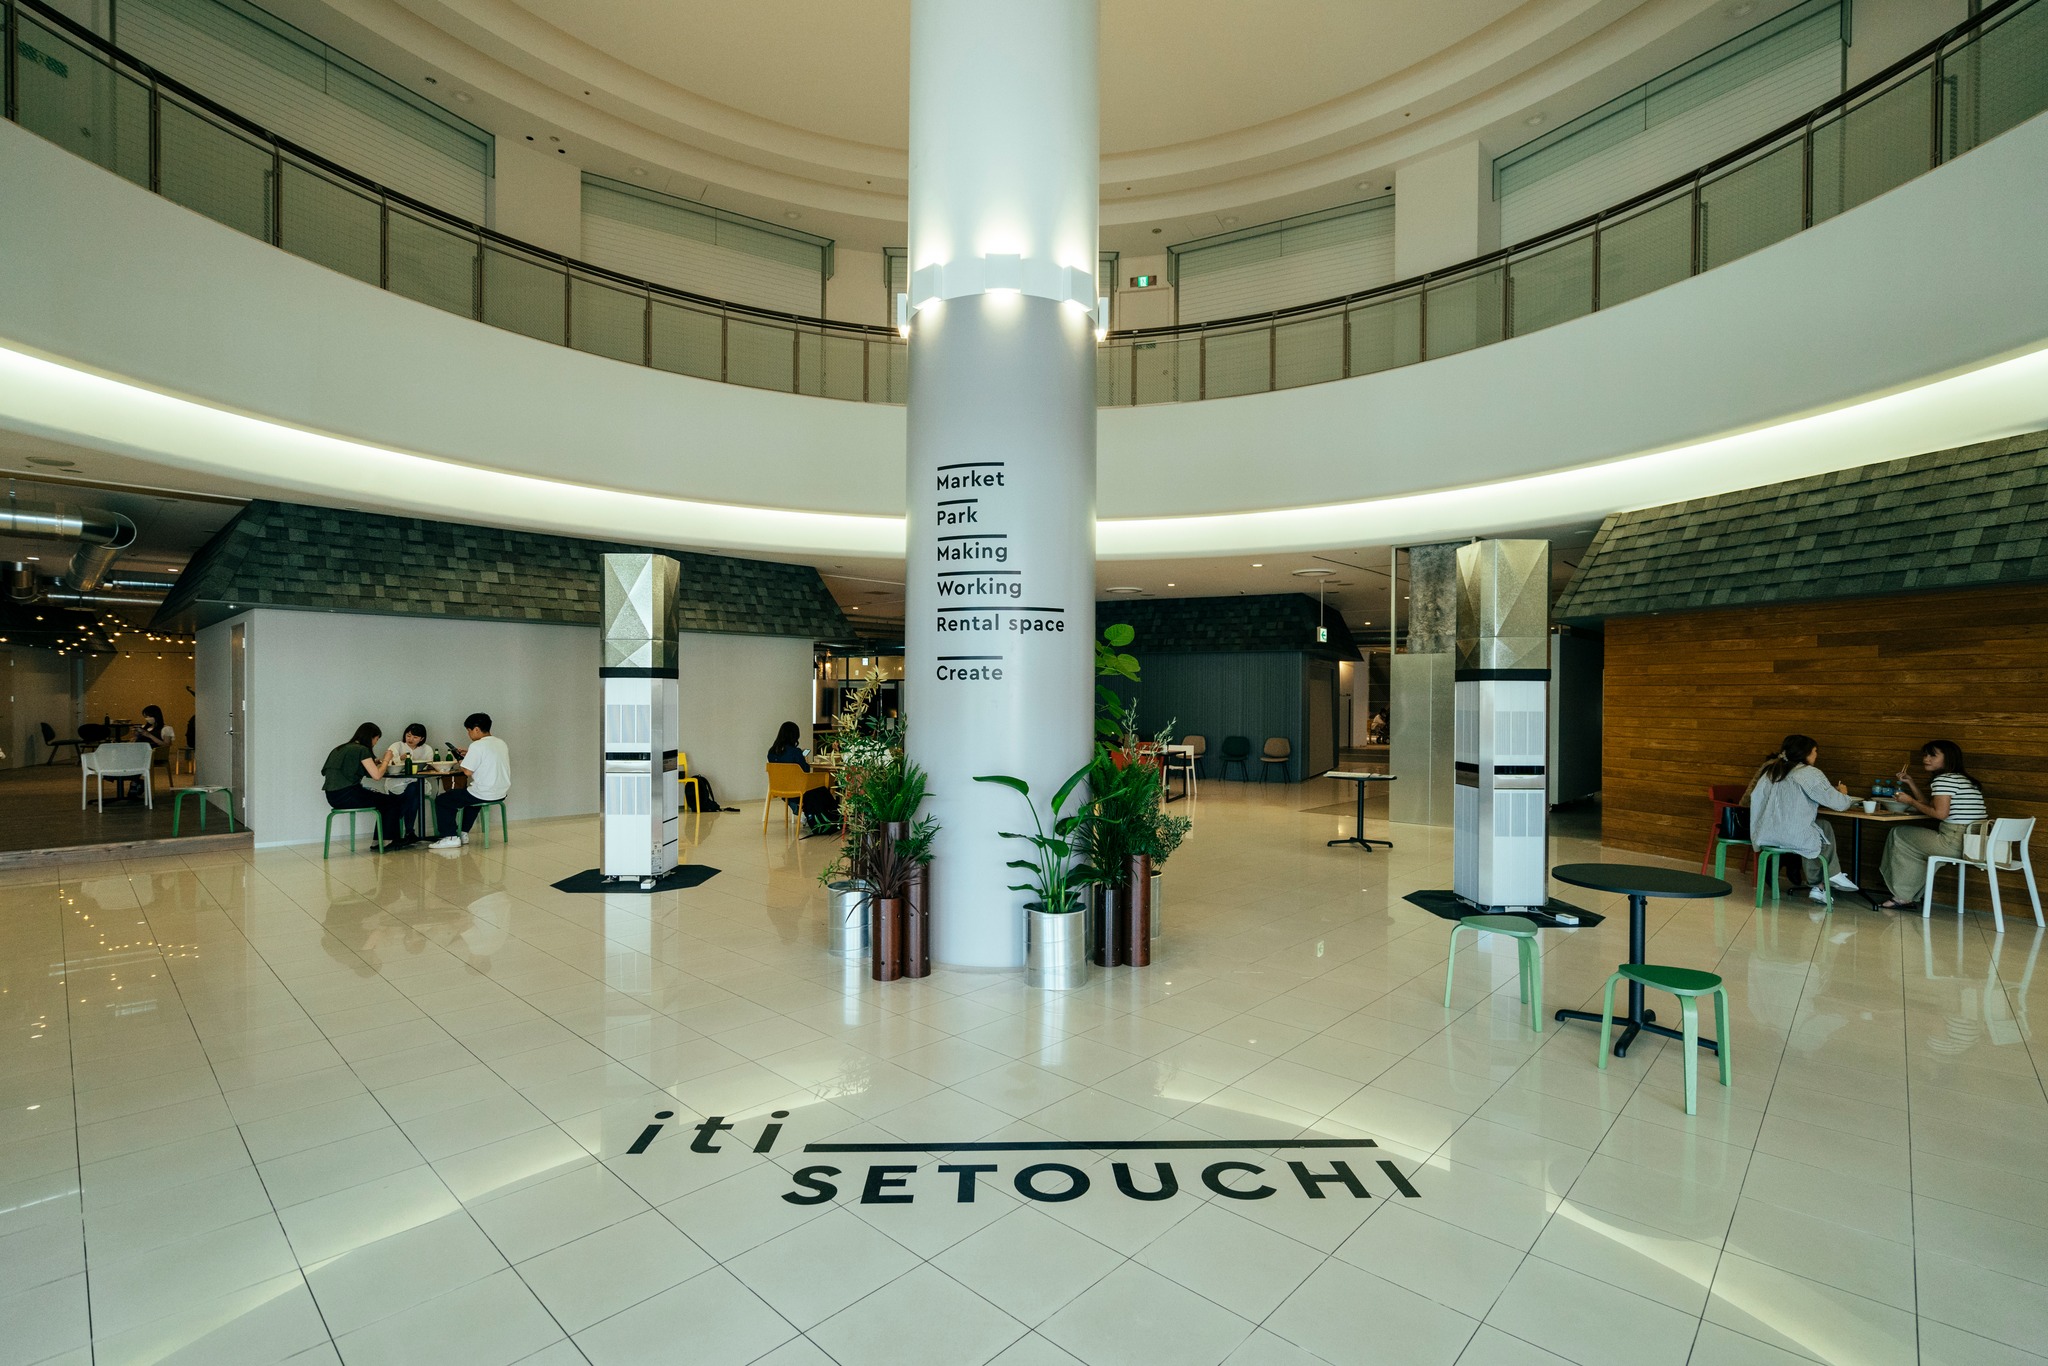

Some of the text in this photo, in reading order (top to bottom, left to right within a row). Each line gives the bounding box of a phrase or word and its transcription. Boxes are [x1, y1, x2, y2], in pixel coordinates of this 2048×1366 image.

[936, 469, 1005, 491] Market
[936, 505, 979, 527] Park
[936, 541, 1008, 563] Making
[936, 576, 1022, 599] Working
[936, 613, 1065, 635] Rental space
[936, 664, 1004, 681] Create
[625, 1110, 791, 1155] iti
[780, 1160, 1423, 1206] SETOUCHI
